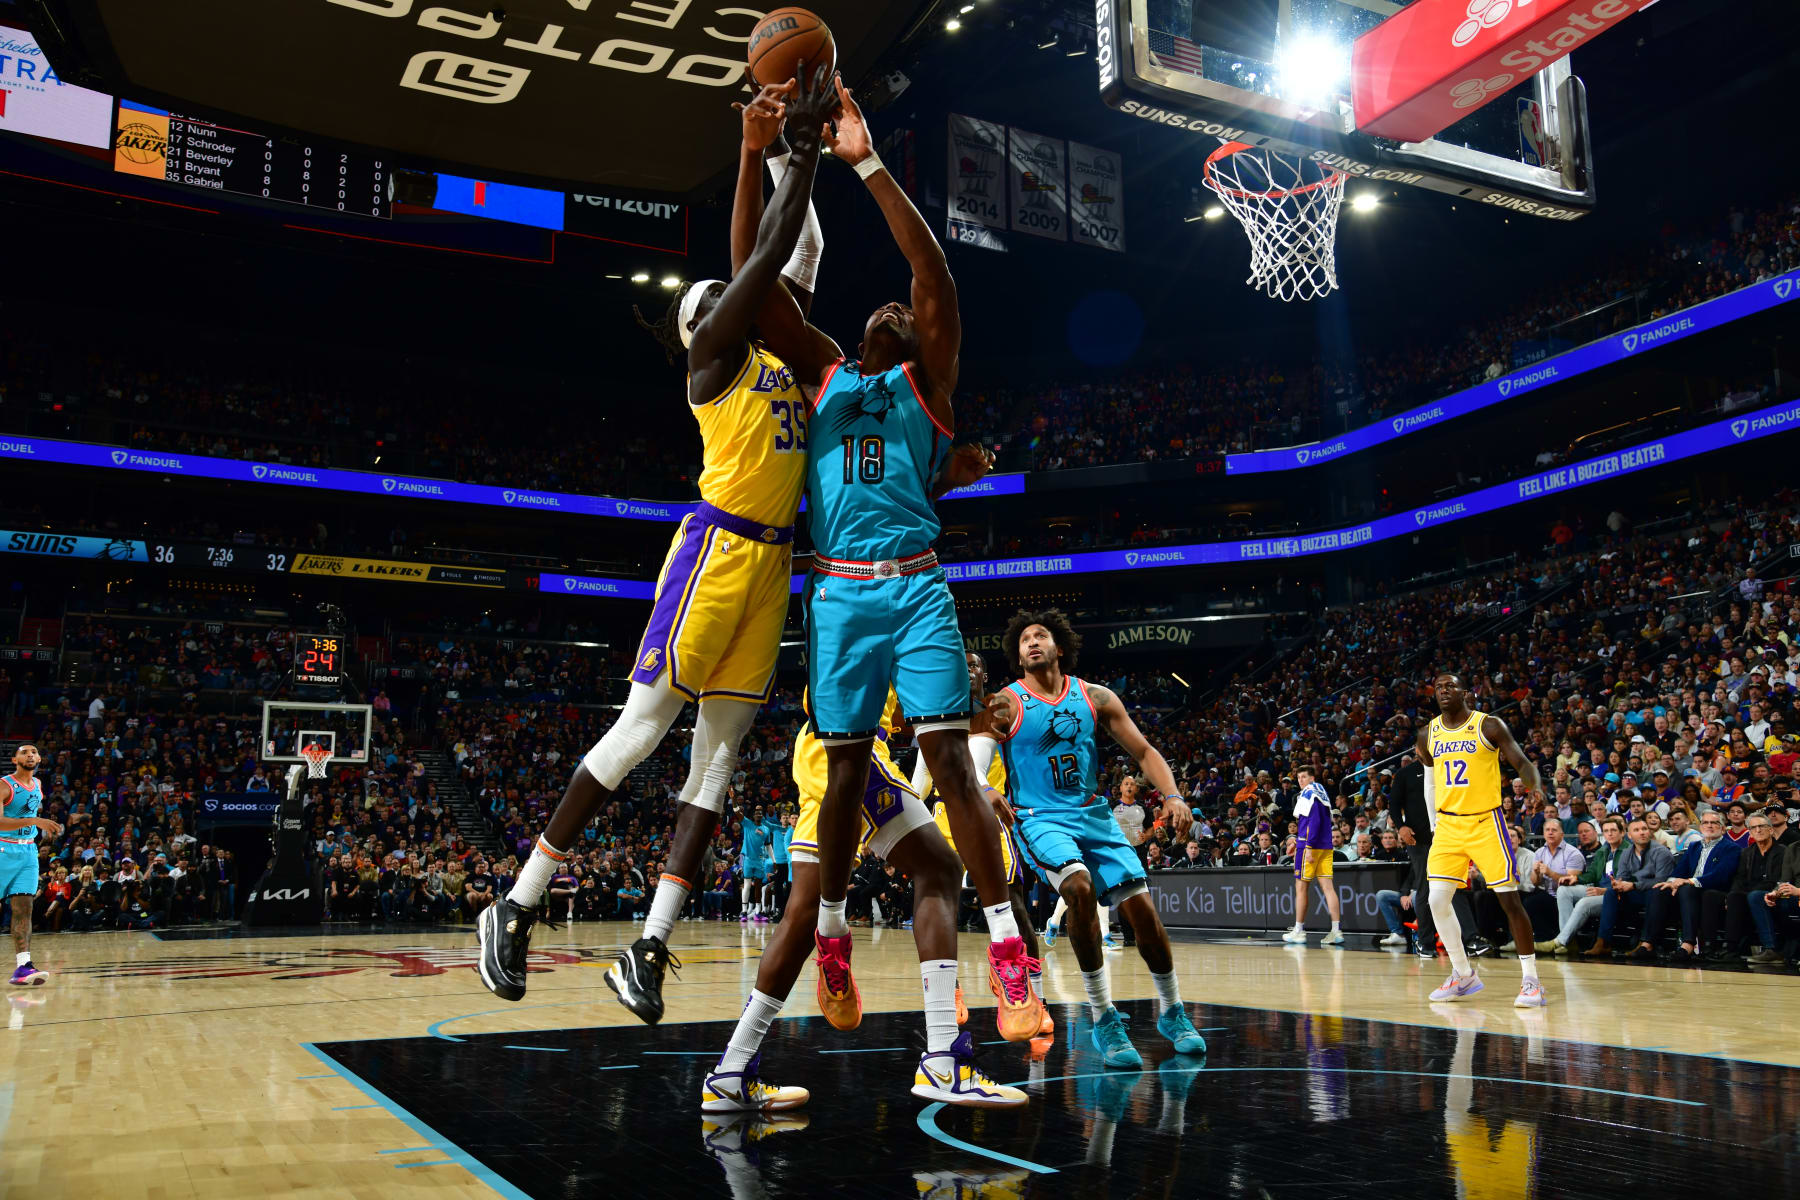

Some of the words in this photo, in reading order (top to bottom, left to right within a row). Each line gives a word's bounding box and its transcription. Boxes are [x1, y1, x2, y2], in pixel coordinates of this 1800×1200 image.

[750, 16, 799, 53] Wilson
[1500, 0, 1630, 73] State
[1120, 100, 1245, 140] SUNS.COM
[116, 129, 167, 158] LAKER
[170, 121, 183, 132] 12
[187, 124, 217, 138] Nunn
[265, 139, 273, 148] 4
[304, 147, 312, 156] 0
[340, 154, 348, 163] 2
[170, 134, 182, 144] 17
[187, 137, 237, 154] Schroder
[265, 151, 272, 160] 0
[304, 159, 311, 168] 0
[339, 166, 347, 175] 0
[374, 172, 382, 181] 0
[1309, 150, 1423, 184] SUNS.COM
[168, 146, 181, 157] 21
[186, 149, 234, 168] Beverley
[264, 163, 272, 173] 0
[303, 171, 310, 180] 8
[339, 178, 346, 187] 2
[373, 184, 381, 193] 0
[166, 159, 180, 169] 31
[185, 161, 221, 177] Bryant
[263, 176, 271, 185] 8
[302, 183, 310, 193] 0
[338, 190, 346, 199] 0
[373, 196, 380, 205] 0
[166, 171, 180, 182] 35
[184, 174, 224, 190] Gabriel
[262, 188, 270, 197] 0
[302, 196, 308, 205] 1
[337, 202, 345, 211] 0
[372, 207, 380, 217] 0
[956, 196, 998, 220] 2014
[1482, 193, 1584, 222] SUNS.COM
[1019, 209, 1060, 232] 2009
[1079, 221, 1119, 243] 2007
[1641, 317, 1695, 344] FANDUEL
[1513, 366, 1559, 390] FANDUEL
[771, 400, 808, 454] 35
[1405, 407, 1444, 428] FANDUEL
[841, 434, 885, 485] 18
[1312, 441, 1347, 459] FANDUEL
[130, 455, 183, 469] FANDUEL
[1519, 480, 1543, 498] FEEL
[1544, 471, 1567, 491] LIKE
[1569, 468, 1577, 485] A
[1578, 457, 1620, 482] BUZZER
[1621, 443, 1666, 470] BEATER
[269, 469, 319, 483] FANDUEL
[398, 482, 444, 495] FANDUEL
[517, 494, 561, 507] FANDUEL
[629, 505, 671, 517] FANDUEL
[1428, 503, 1467, 521] FANDUEL
[8, 532, 77, 554] SUNS
[1241, 543, 1265, 557] FEEL
[1267, 541, 1290, 556] LIKE
[1292, 539, 1300, 553] A
[1301, 534, 1340, 553] BUZZER
[1340, 526, 1373, 546] BEATER
[154, 545, 175, 564] 36
[207, 547, 234, 562] 7:36
[267, 553, 286, 572] 32
[299, 555, 345, 574] LAKERS
[1141, 551, 1185, 563] FANDUEL
[352, 564, 423, 576] LAKERS
[966, 563, 986, 577] LIKE
[988, 563, 995, 576] A
[997, 560, 1034, 575] BUZZER
[1035, 558, 1072, 572] BEATER
[578, 581, 619, 592] FANDUEL
[312, 638, 337, 652] 7:36
[1107, 625, 1193, 650] JAMESON
[304, 650, 333, 672] 24
[309, 675, 339, 683] TISSOT
[1433, 740, 1477, 759] LAKERS
[1048, 753, 1080, 790] 12
[1444, 759, 1470, 787] 12
[1149, 886, 1180, 913] The
[1186, 886, 1215, 914] Kia
[1221, 885, 1297, 916] Tellurid
[1339, 885, 1380, 916] Pro
